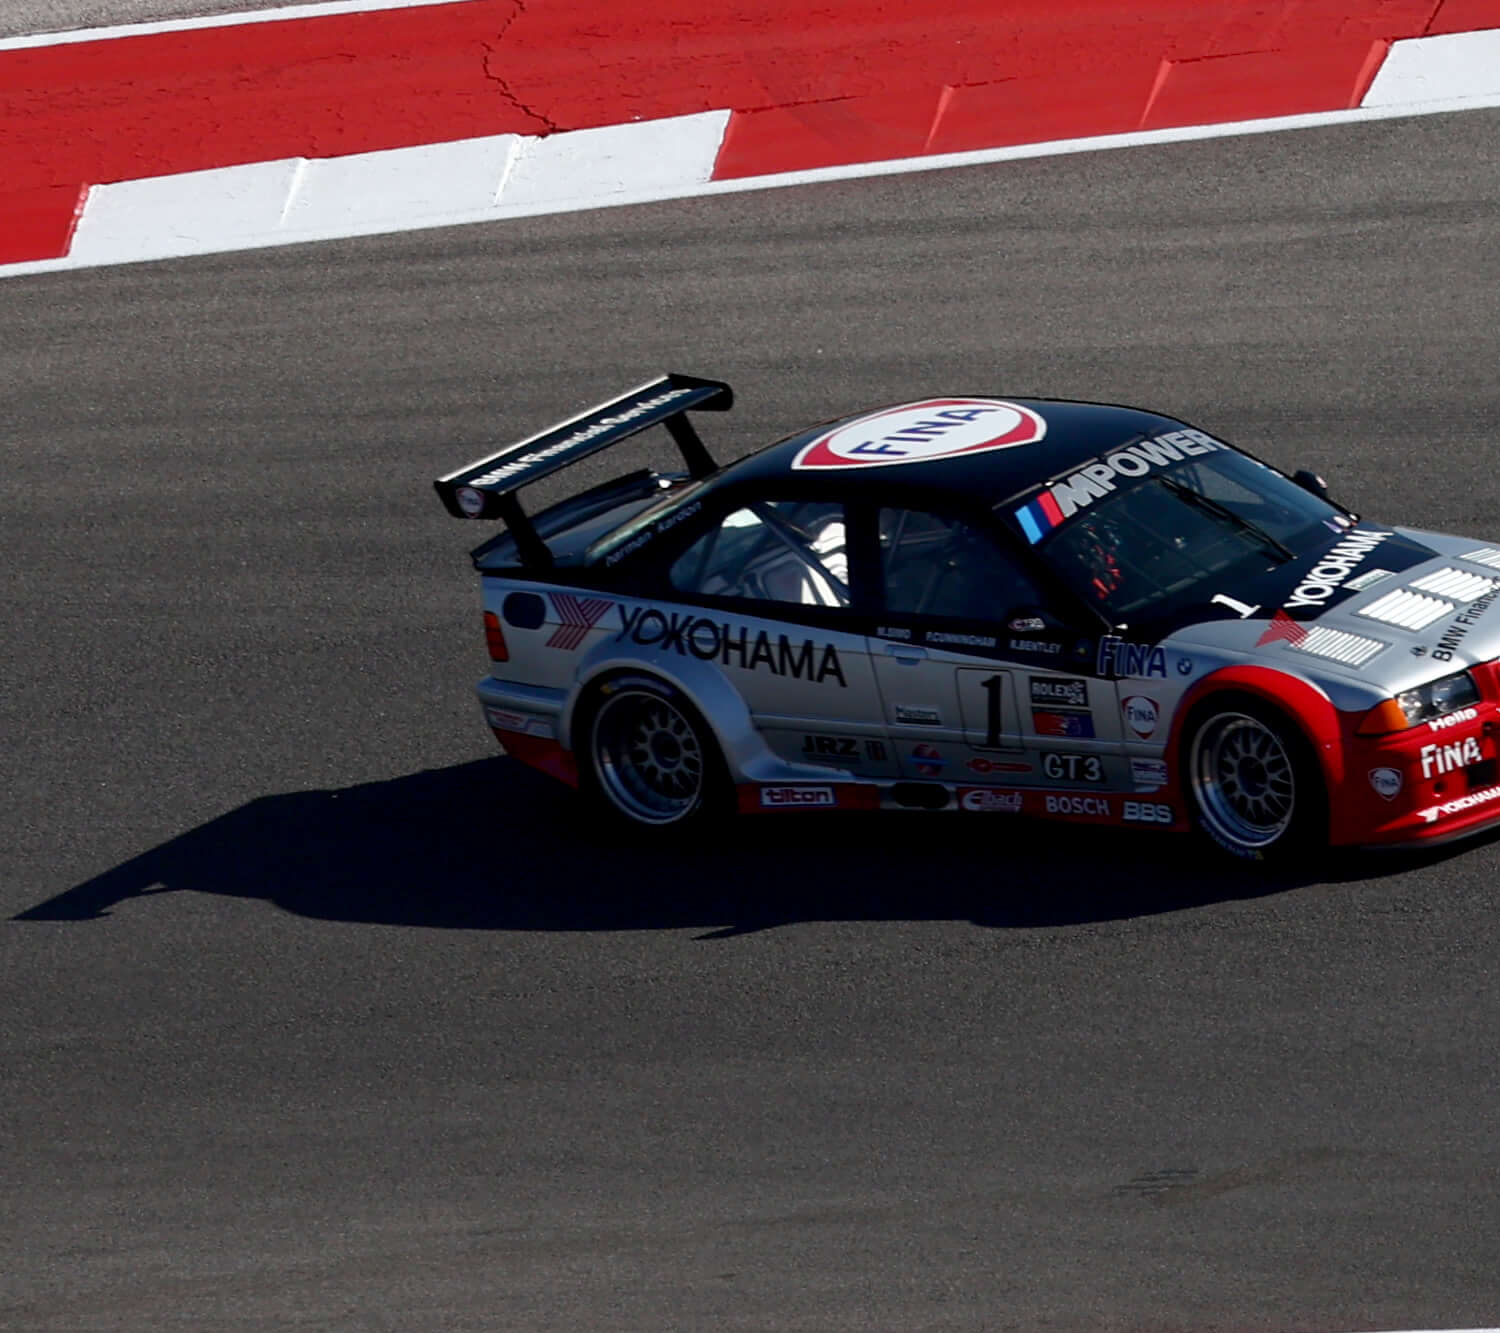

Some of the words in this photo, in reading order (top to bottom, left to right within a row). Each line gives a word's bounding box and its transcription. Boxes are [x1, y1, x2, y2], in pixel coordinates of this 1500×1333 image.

[848, 406, 1002, 457] FINA
[1284, 529, 1395, 609] YOKOHAMA
[1211, 593, 1261, 620] 1
[616, 603, 847, 688] YOKOHAMA
[1096, 634, 1168, 679] FINA
[1431, 624, 1468, 662] BMW
[981, 675, 1002, 749] 1
[1127, 705, 1156, 723] FINA
[801, 735, 860, 757] JRZ
[1044, 795, 1111, 816] BOSCH
[1121, 800, 1174, 824] BBS
